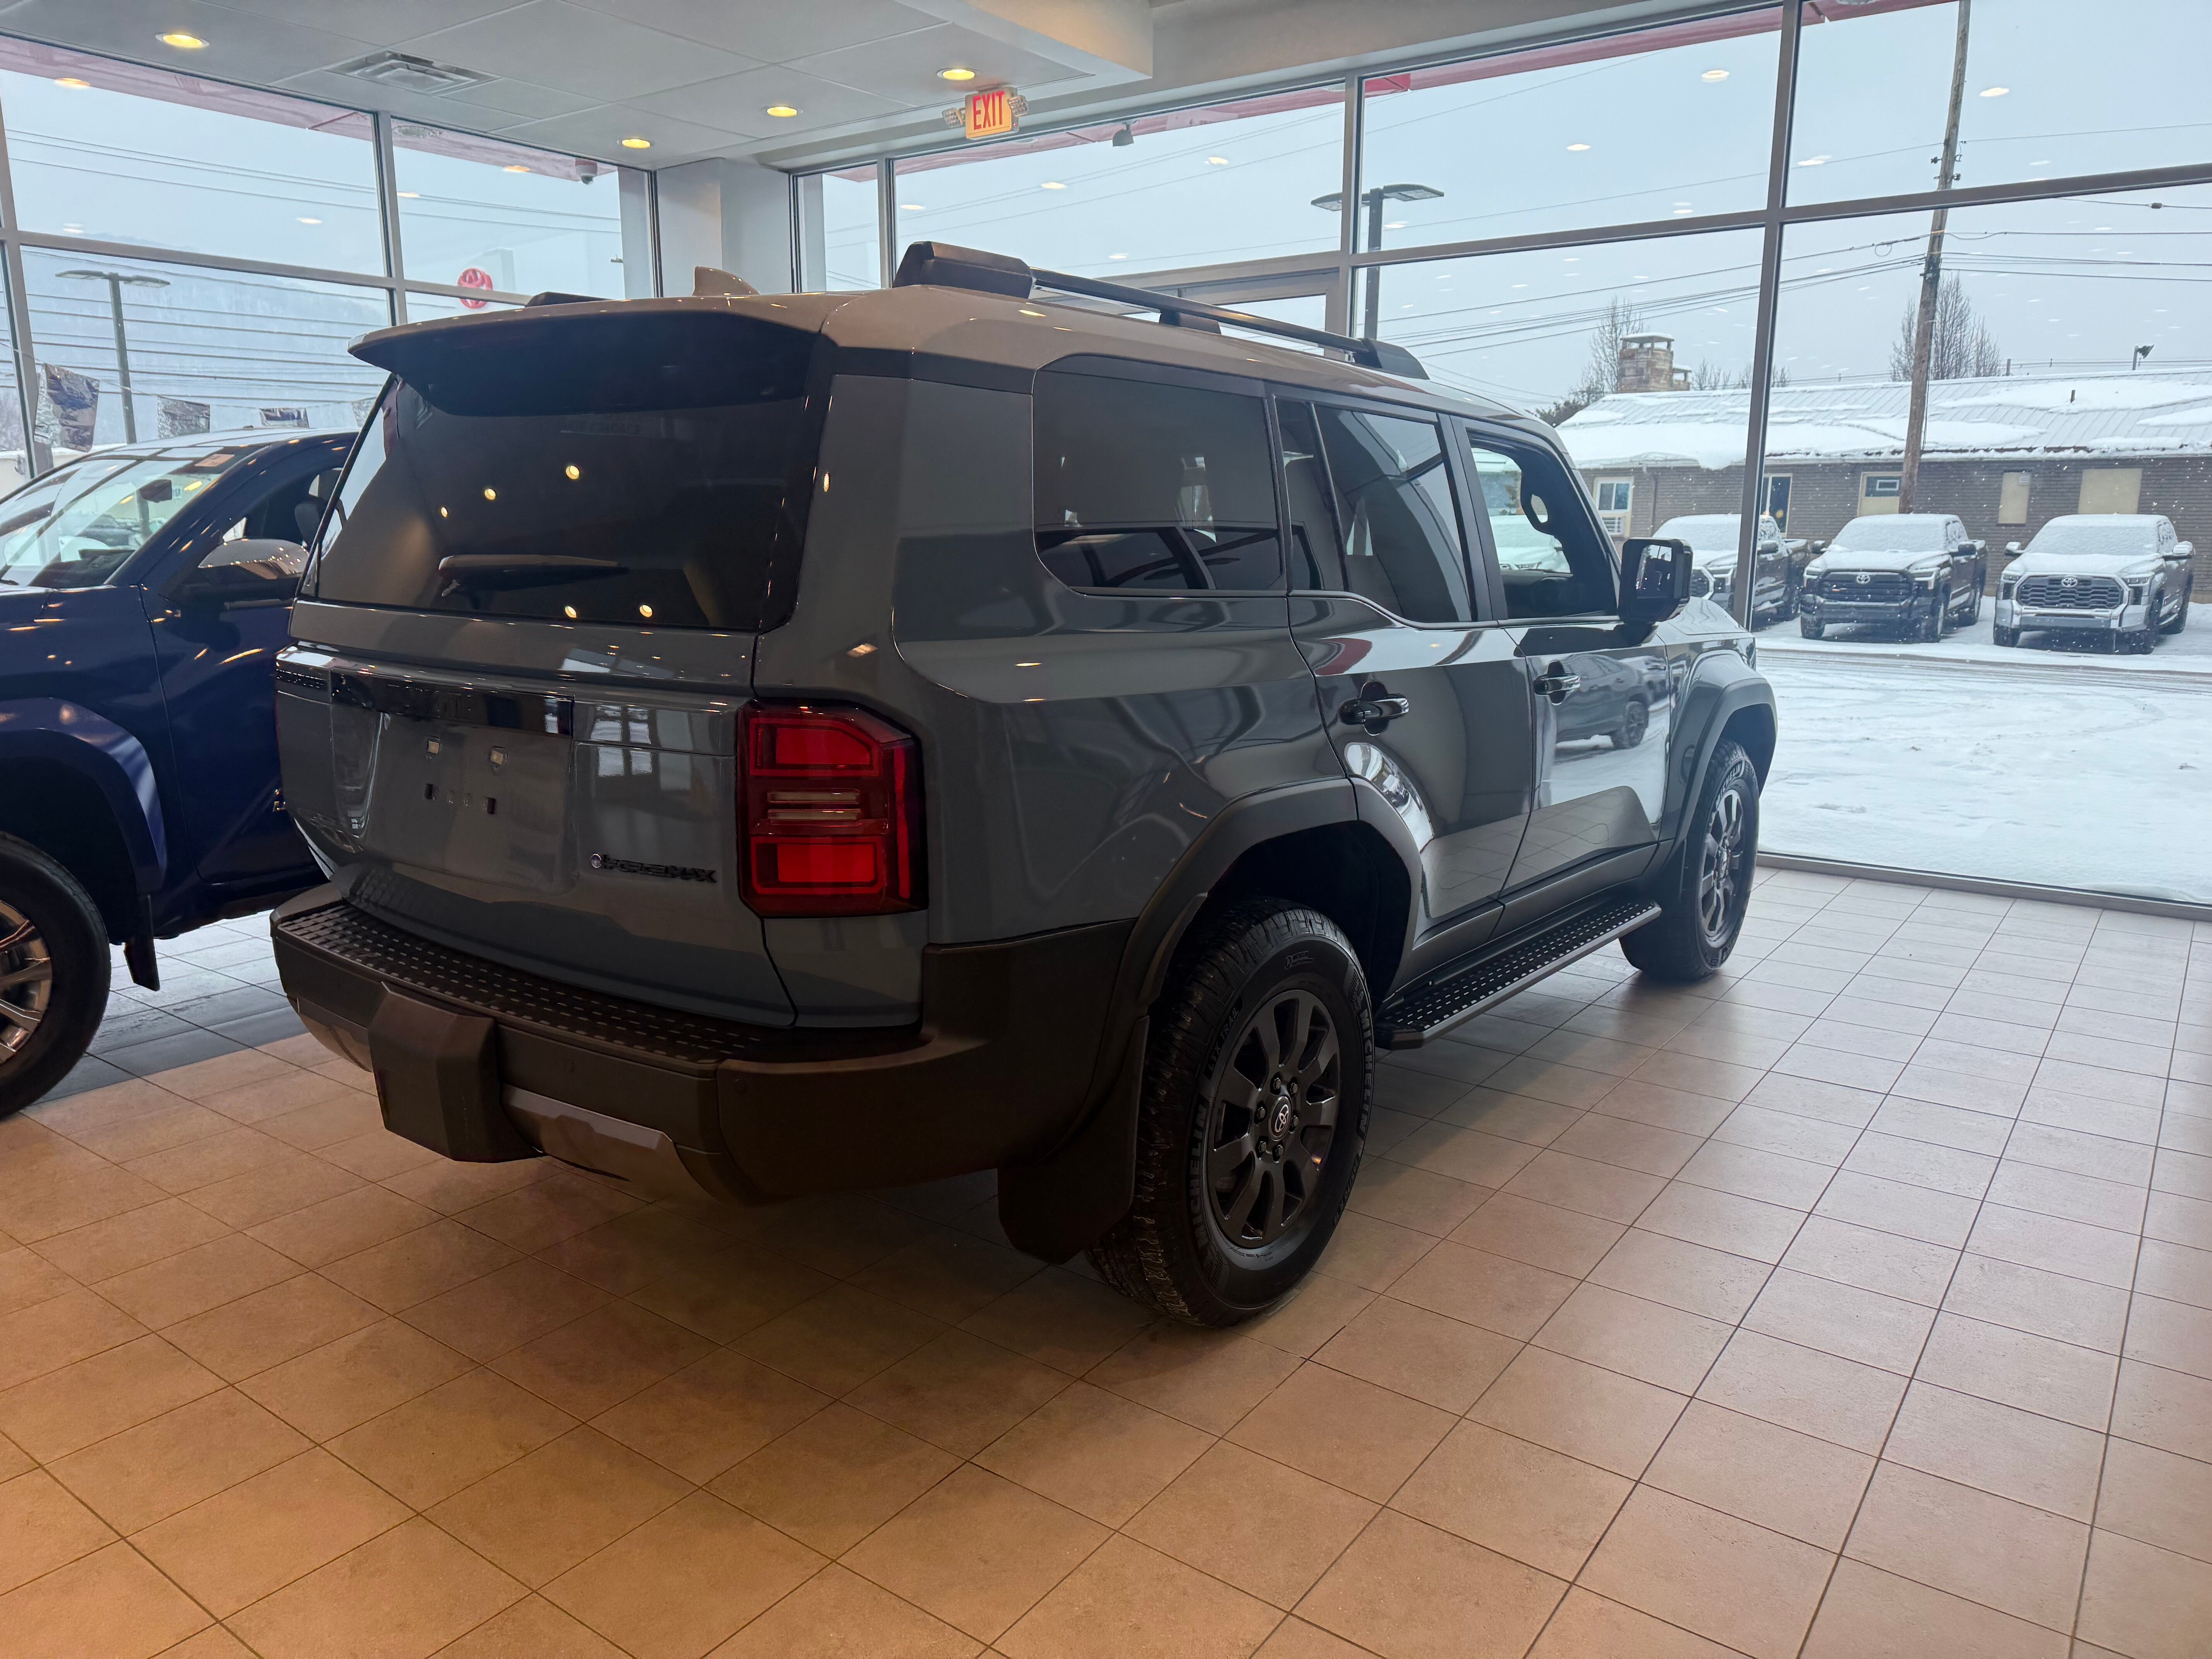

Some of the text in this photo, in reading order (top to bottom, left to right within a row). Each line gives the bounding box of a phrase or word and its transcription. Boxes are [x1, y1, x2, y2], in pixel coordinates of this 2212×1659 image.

[972, 90, 1005, 130] EXIT
[1207, 1006, 1239, 1072] LTX TRAIL
[1359, 1011, 1374, 1133] MICHELIN
[1189, 1103, 1209, 1249] MICHELIN
